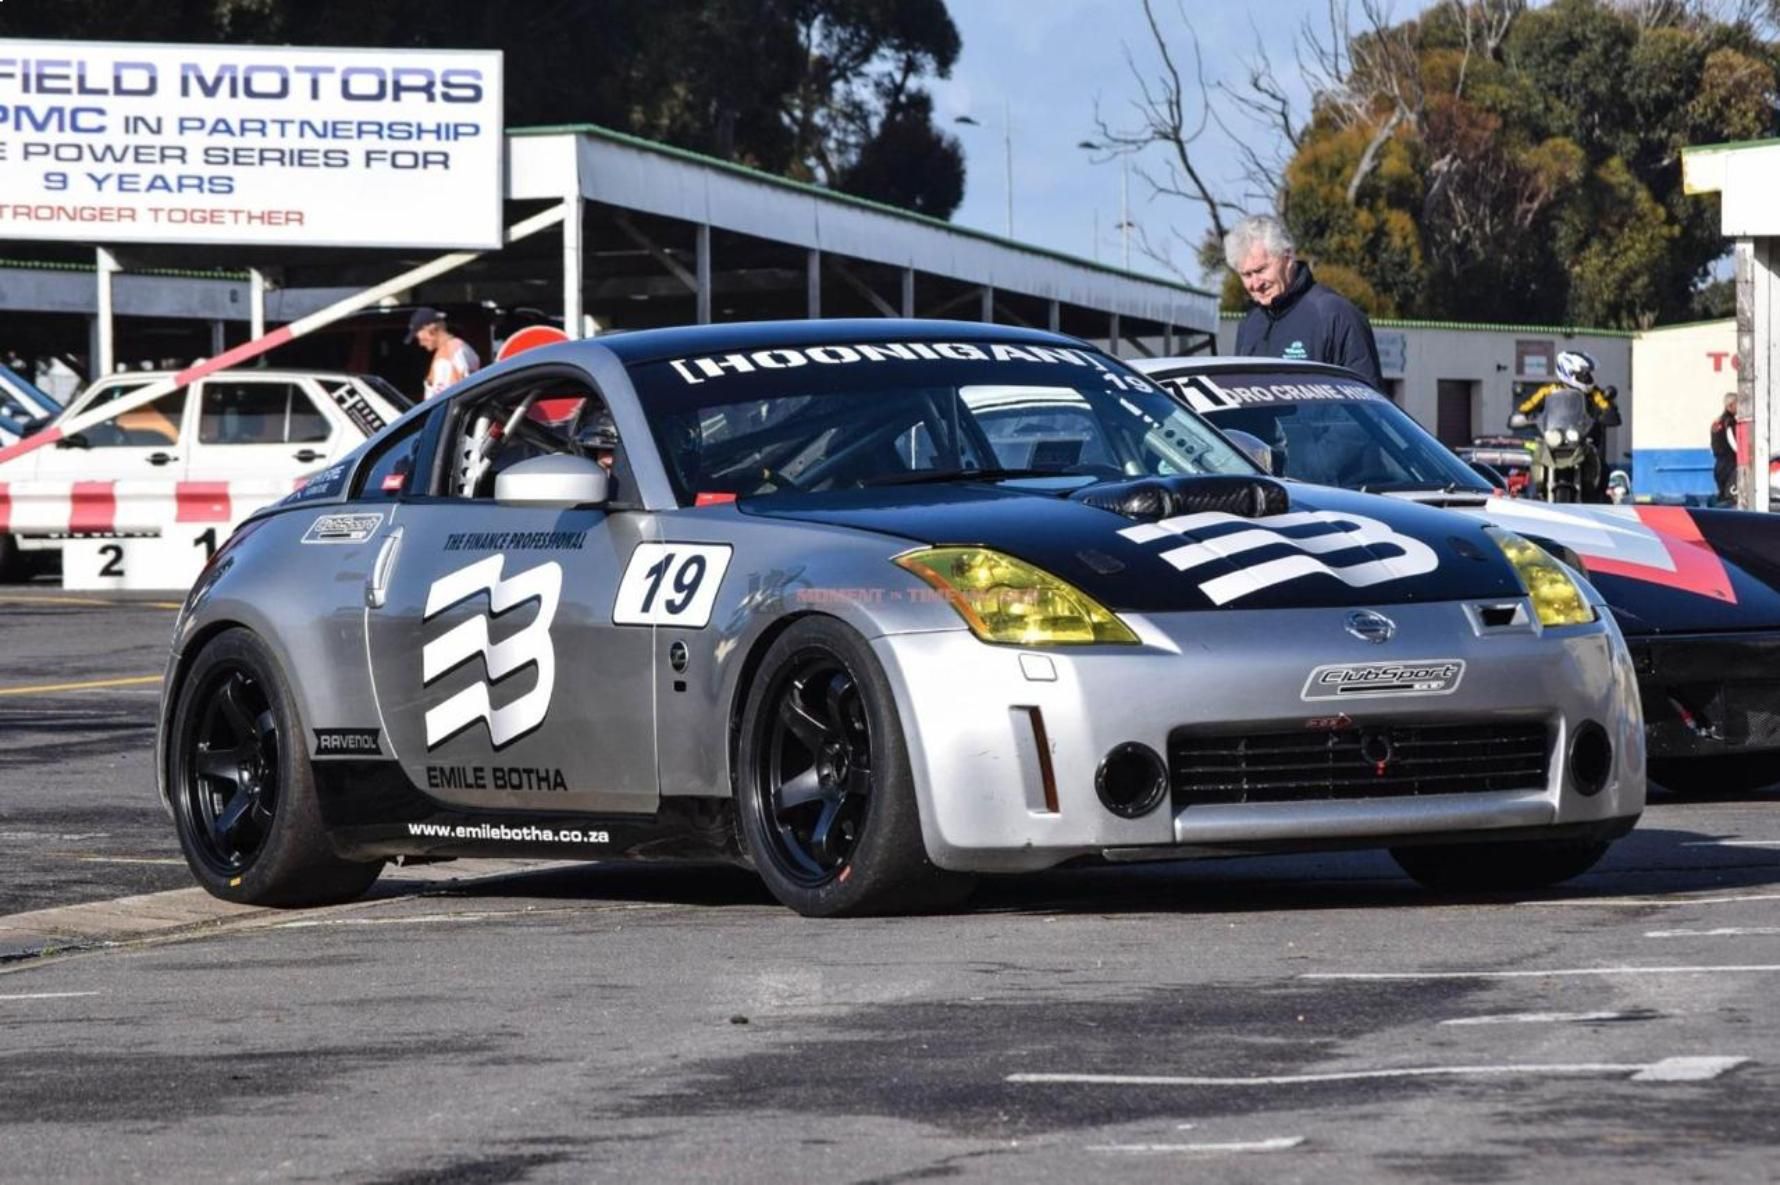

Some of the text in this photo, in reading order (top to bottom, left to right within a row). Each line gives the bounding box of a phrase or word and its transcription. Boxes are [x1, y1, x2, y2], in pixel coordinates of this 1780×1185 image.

[181, 63, 483, 104] MOTORS
[124, 115, 163, 135] IN
[178, 116, 481, 142] PARTNERSHIP
[23, 142, 187, 165] POWER
[203, 146, 350, 169] SERIES
[365, 150, 450, 170] FOR
[43, 171, 235, 194] 9 YEARS
[148, 207, 305, 226] TOGETHER
[1103, 373, 1154, 393] 19
[1271, 385, 1344, 400] CRANE
[193, 527, 217, 562] 1
[444, 531, 587, 550] THE FINANCE PROFESSIONAL
[98, 544, 125, 577] 2
[640, 553, 707, 616] 19
[1320, 664, 1458, 684] ClubSport
[319, 734, 378, 750] RAVENOL
[427, 766, 568, 791] EMILE BOTHA
[408, 822, 610, 844] www.emilebotha.co.za
